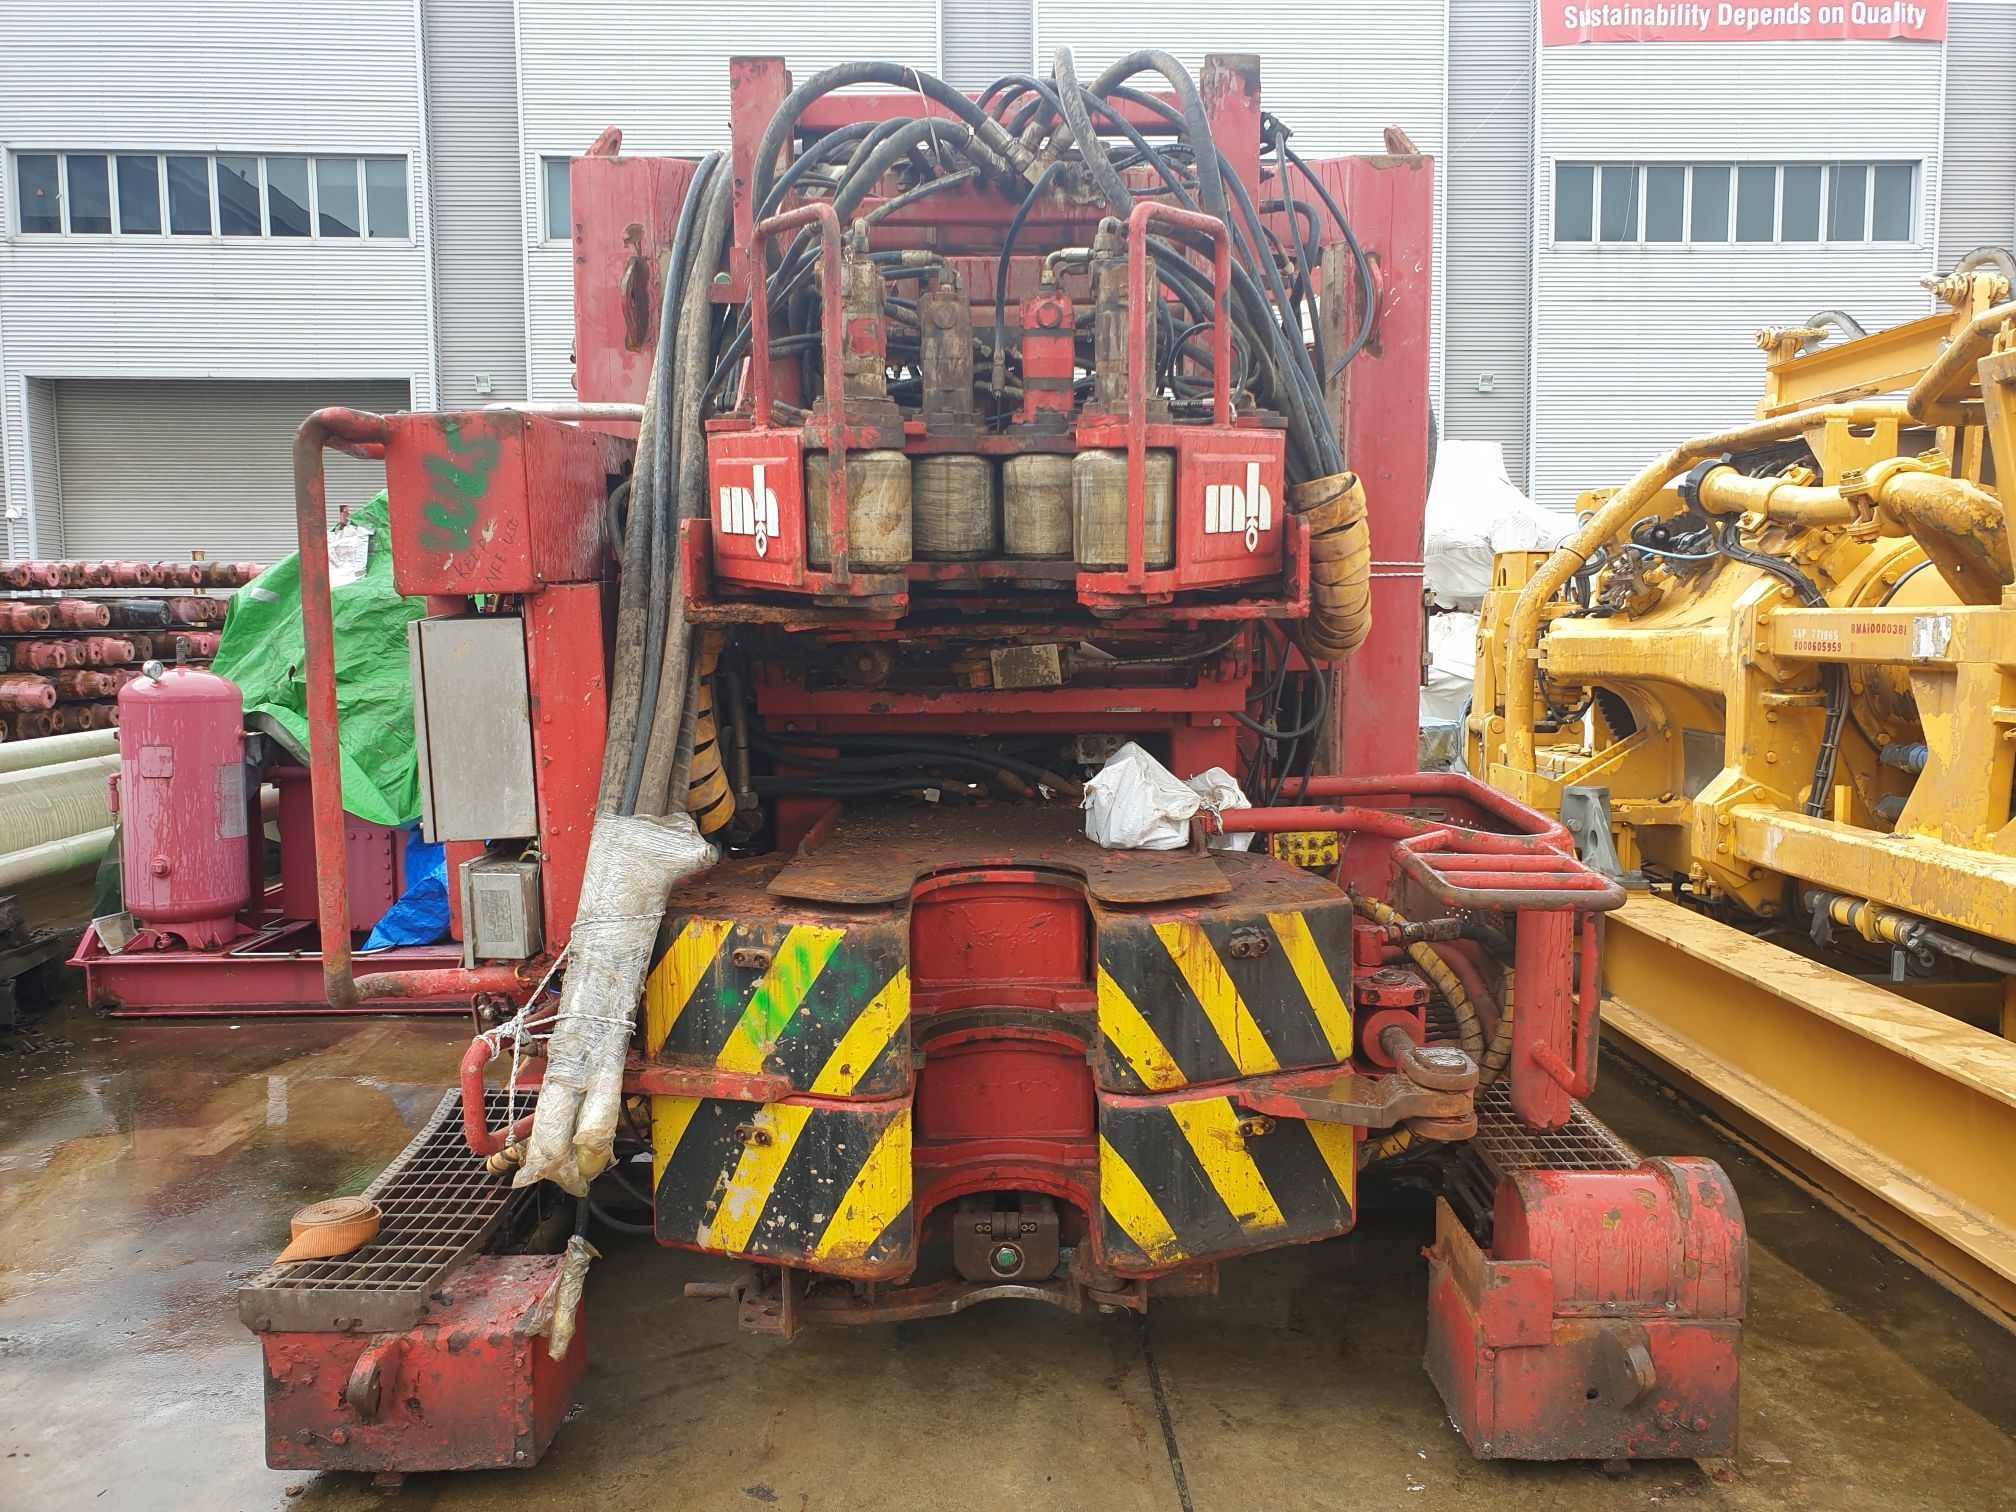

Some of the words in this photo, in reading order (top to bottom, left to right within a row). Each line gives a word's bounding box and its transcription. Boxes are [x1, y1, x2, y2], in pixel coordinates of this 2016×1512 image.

[1563, 3, 1711, 32] Sustainability
[1717, 1, 1811, 31] Depends
[1818, 5, 1844, 25] on
[1850, 1, 1927, 29] Quality
[1793, 640, 1842, 652] 8000605959
